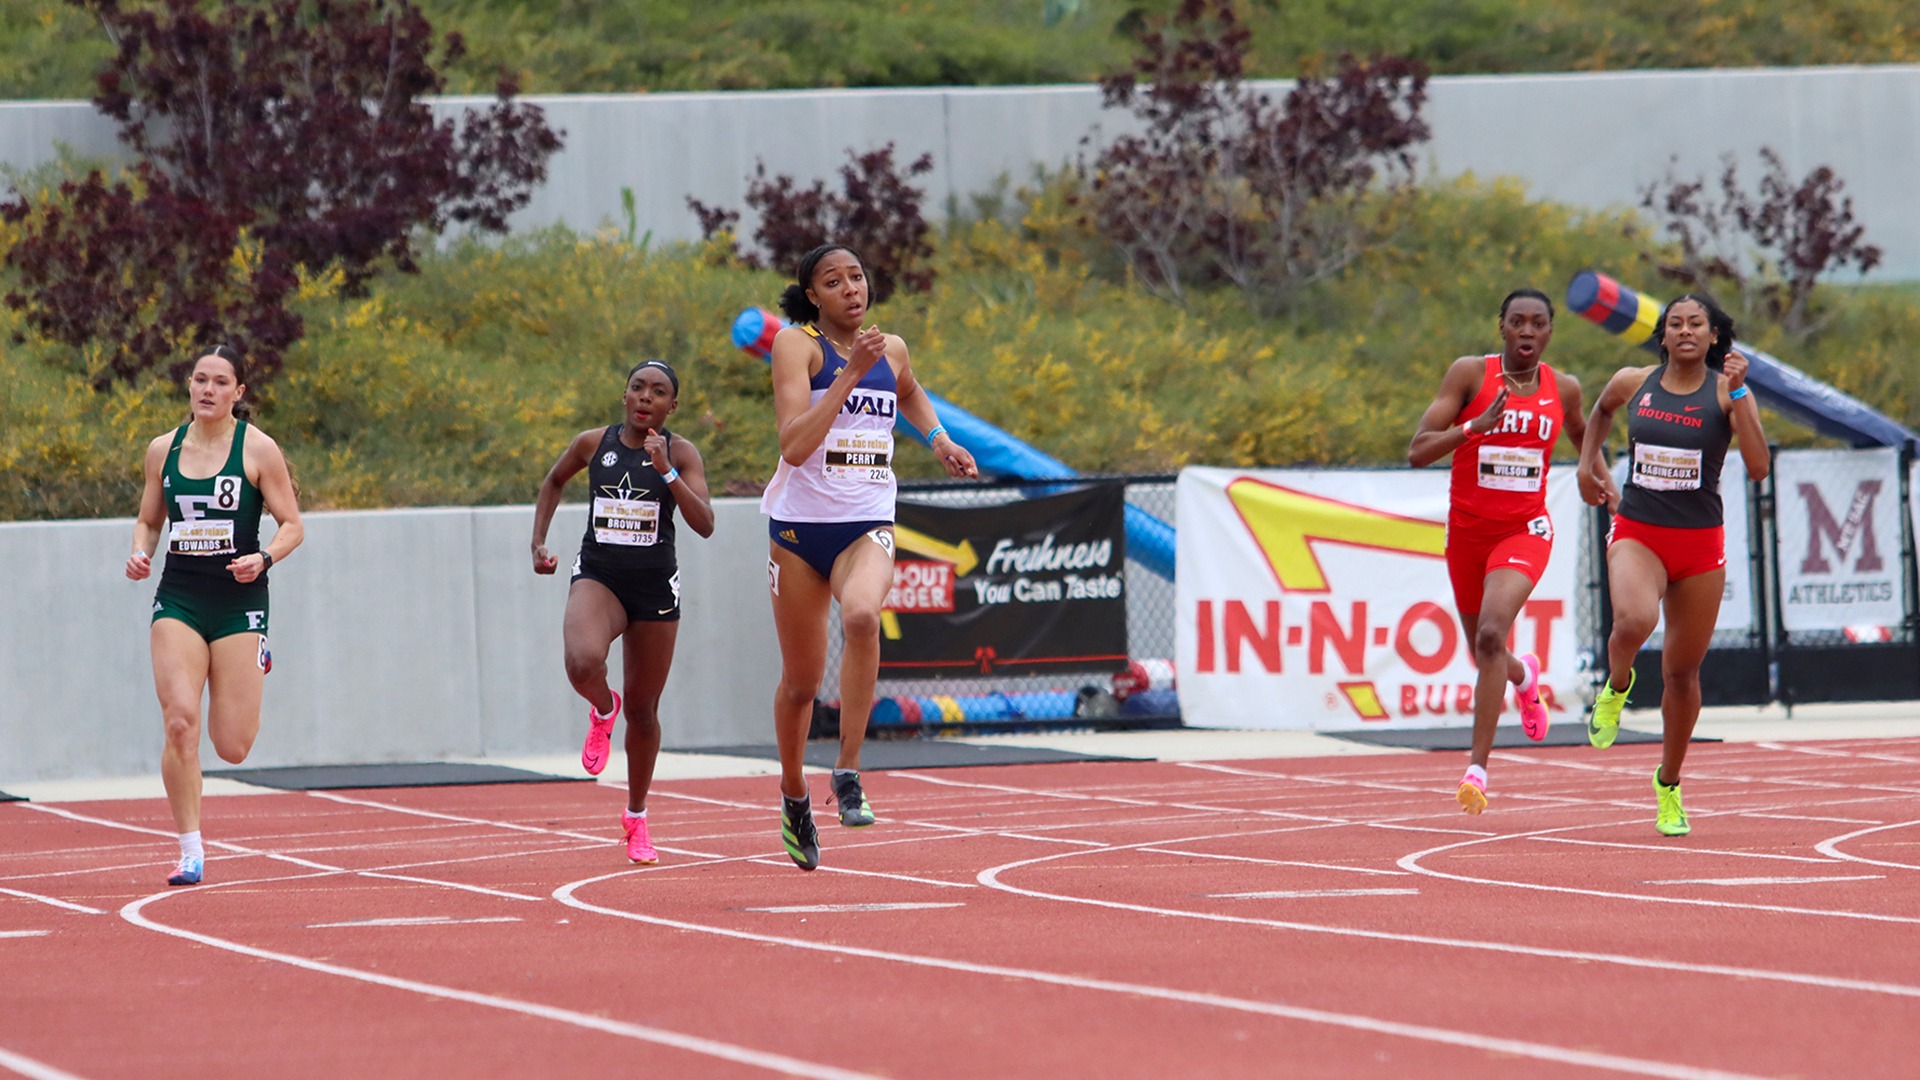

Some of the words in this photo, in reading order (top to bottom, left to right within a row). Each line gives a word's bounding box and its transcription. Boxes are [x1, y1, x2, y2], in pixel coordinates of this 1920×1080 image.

[838, 396, 894, 418] NAU
[1538, 414, 1553, 441] U
[1637, 407, 1703, 428] HOUSTON
[852, 440, 866, 449] sac
[846, 453, 876, 465] PERRY
[1493, 465, 1528, 477] WILSON
[1641, 464, 1692, 478] BABINEAUX
[218, 478, 235, 509] 8
[607, 518, 641, 530] BROWN
[1797, 480, 1883, 574] M
[178, 540, 221, 551] EDWARDS
[632, 533, 653, 543] 3735
[875, 530, 891, 549] 6
[986, 533, 1112, 574] Freshness
[974, 580, 1012, 604] You
[1014, 579, 1060, 601] Can
[1064, 574, 1122, 600] Taste
[1788, 582, 1893, 604] ATHLETICS
[245, 610, 265, 630] E
